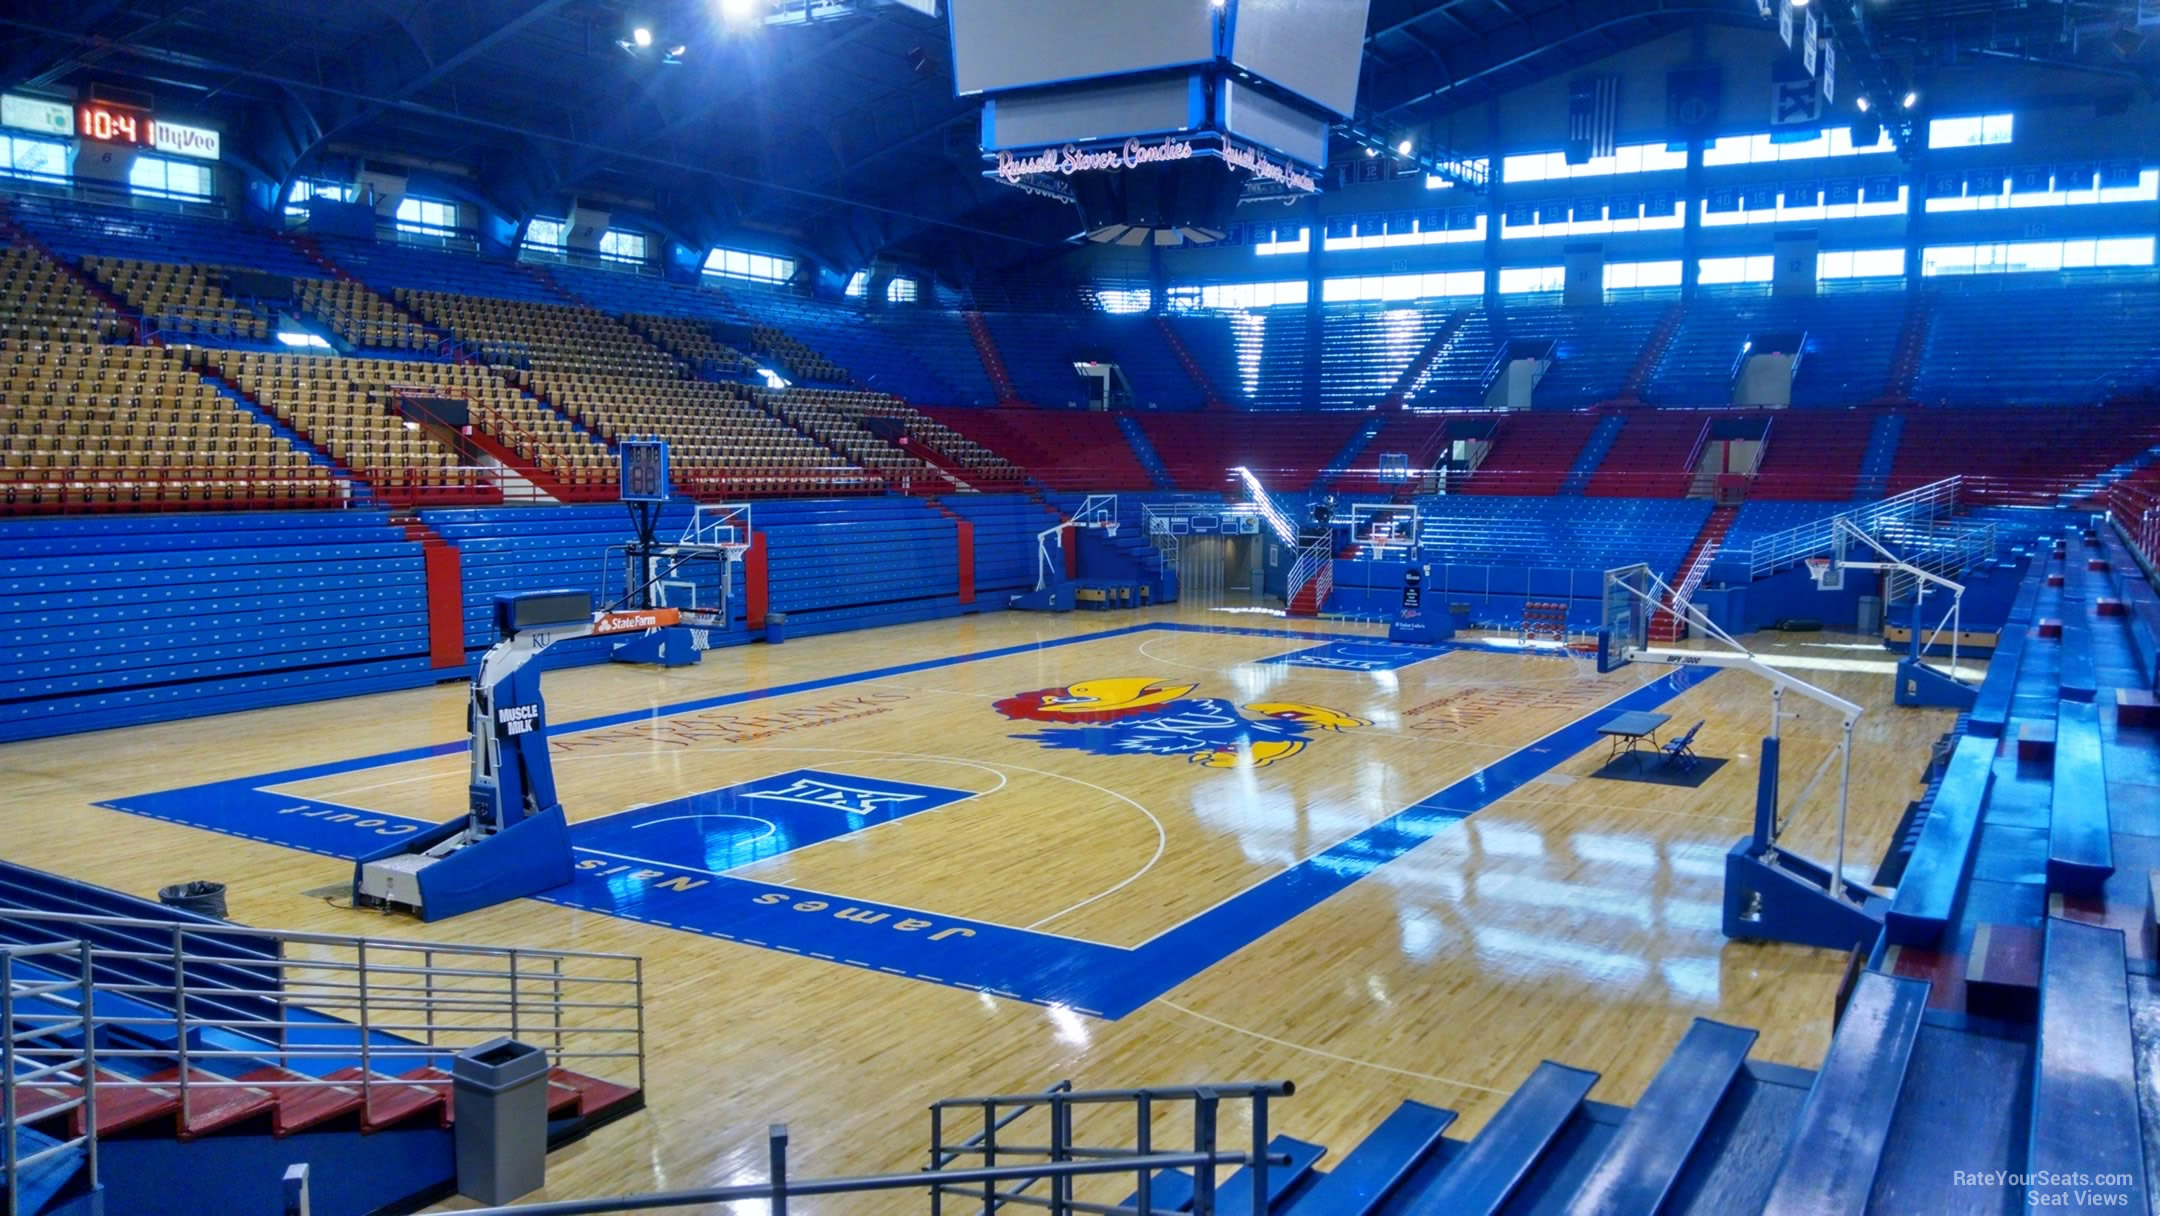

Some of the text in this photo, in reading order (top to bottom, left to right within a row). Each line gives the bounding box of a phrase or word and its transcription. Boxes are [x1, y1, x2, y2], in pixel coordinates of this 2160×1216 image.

[83, 107, 156, 147] 10:41
[102, 152, 112, 162] 6
[996, 136, 1193, 183] Russell Stover Candies
[1366, 165, 1377, 176] 12
[532, 632, 551, 649] KU
[498, 704, 539, 724] MUSCLE
[507, 719, 532, 736] MILK
[549, 713, 739, 753] ANSAS
[276, 805, 419, 835] Court
[575, 858, 977, 942] James Nais
